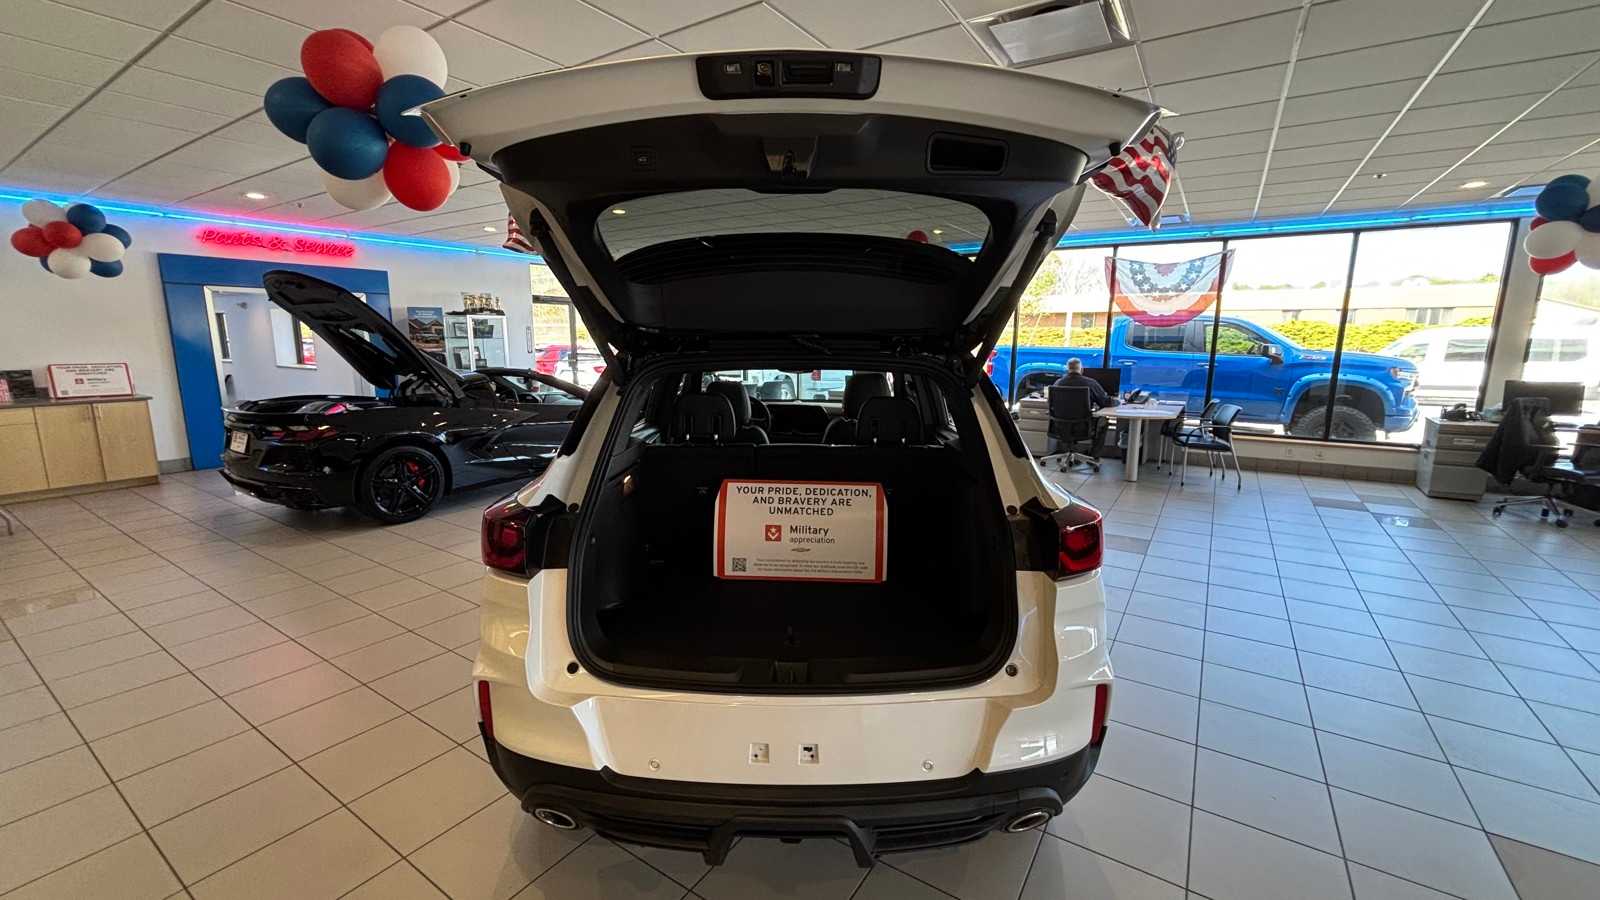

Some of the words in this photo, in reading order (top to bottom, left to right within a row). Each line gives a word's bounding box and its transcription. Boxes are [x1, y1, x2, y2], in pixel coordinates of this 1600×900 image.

[268, 236, 286, 250] &
[736, 485, 764, 495] YOUR
[767, 486, 802, 496] PRIDE,
[805, 487, 872, 498] DEDICATION,
[752, 496, 774, 505] AND
[778, 497, 827, 506] BRAVERY
[830, 498, 852, 506] ARE
[768, 506, 834, 516] UNMATCHED
[789, 525, 830, 536] Military
[789, 536, 836, 544] appreciation
